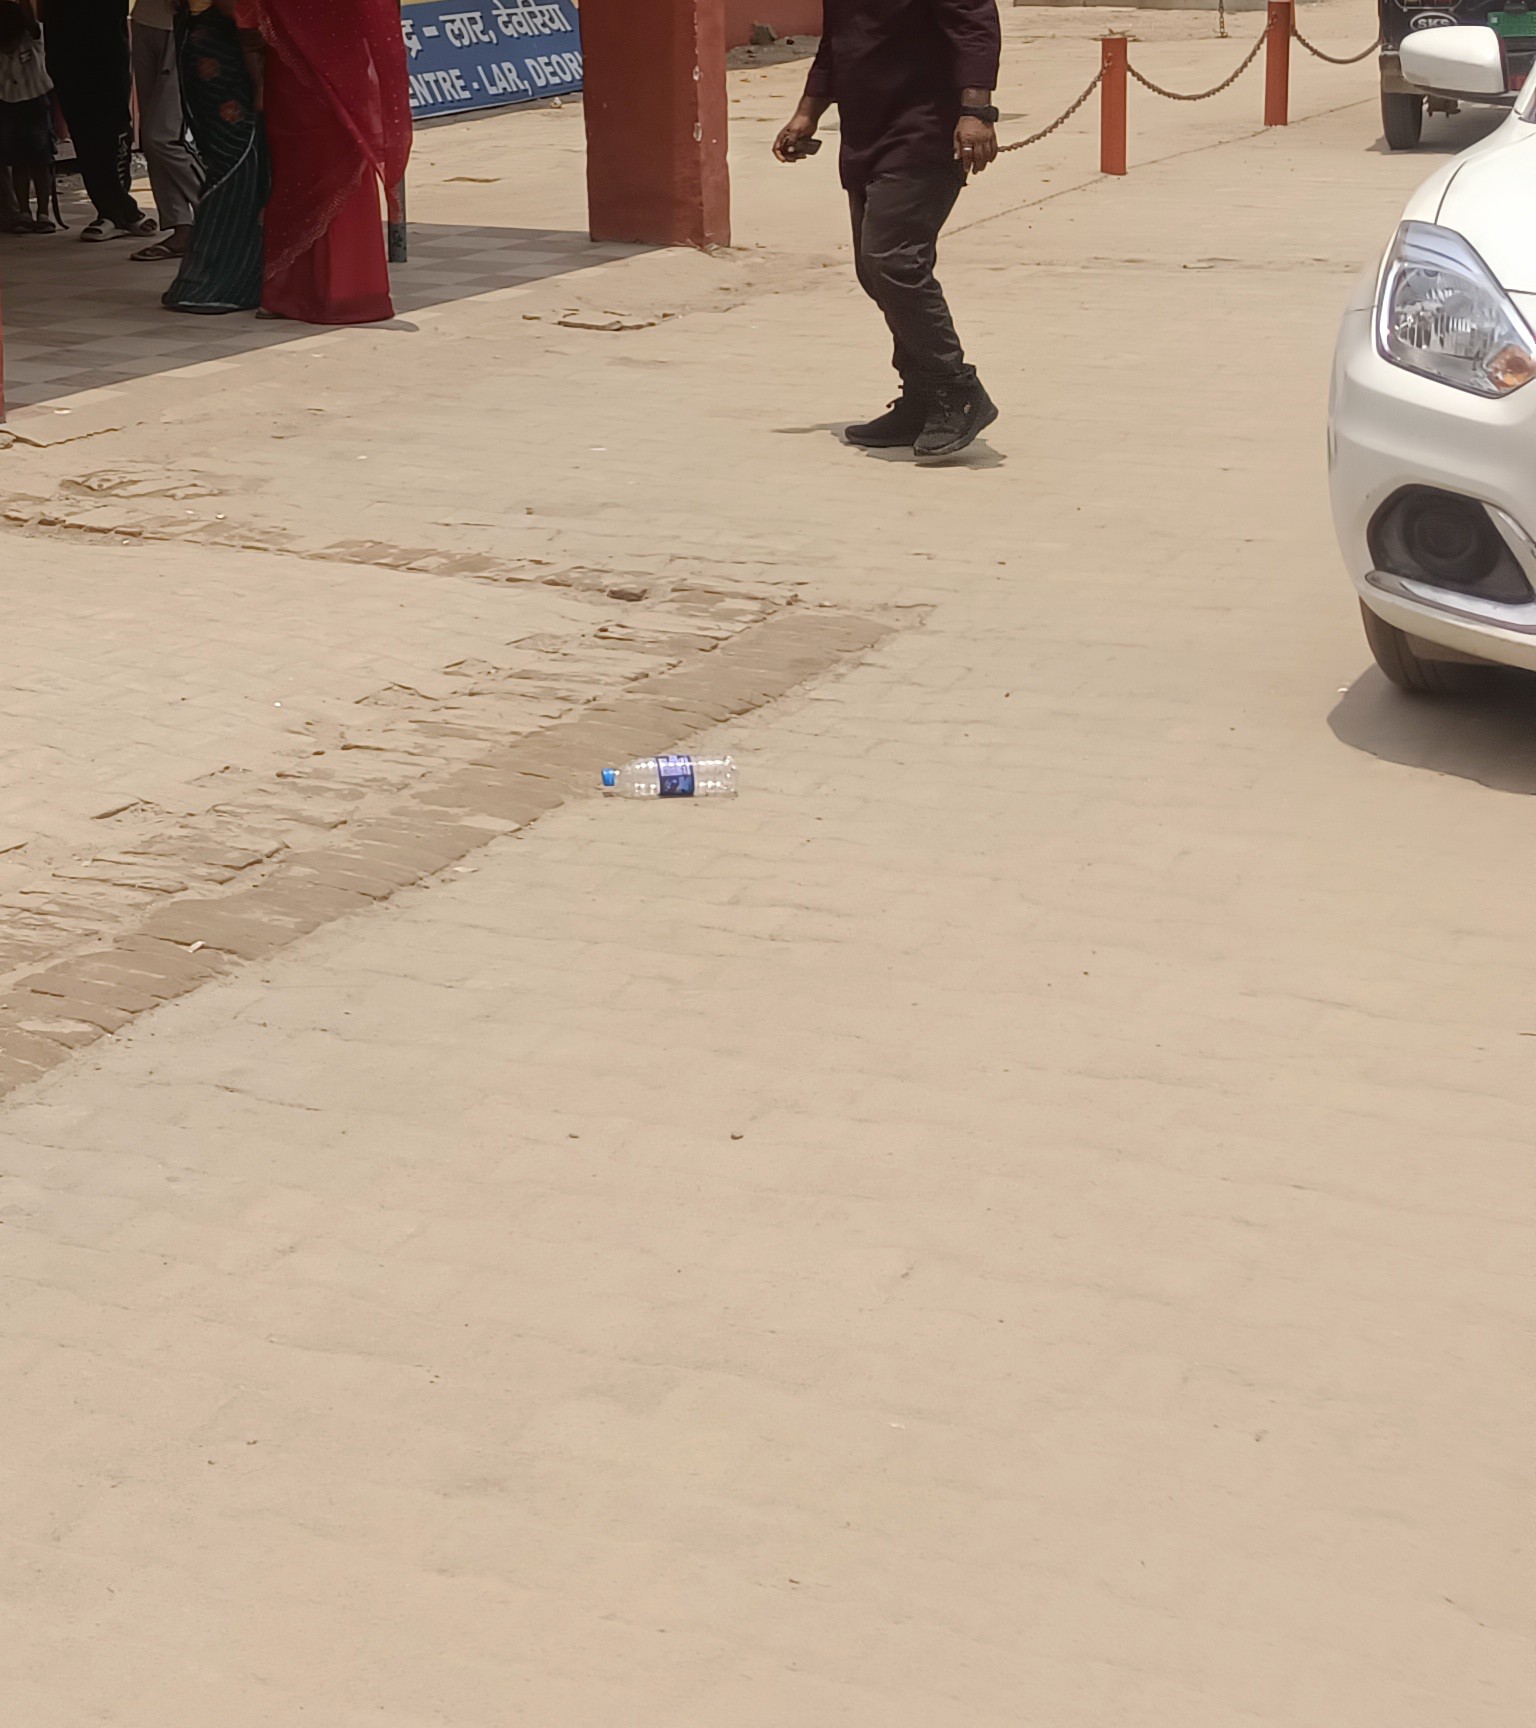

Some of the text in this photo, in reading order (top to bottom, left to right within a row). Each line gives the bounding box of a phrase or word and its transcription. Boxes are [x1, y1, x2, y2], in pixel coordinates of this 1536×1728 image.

[439, 11, 497, 47] लार,
[409, 68, 471, 107] ENTRE
[477, 61, 532, 96] LAR,
